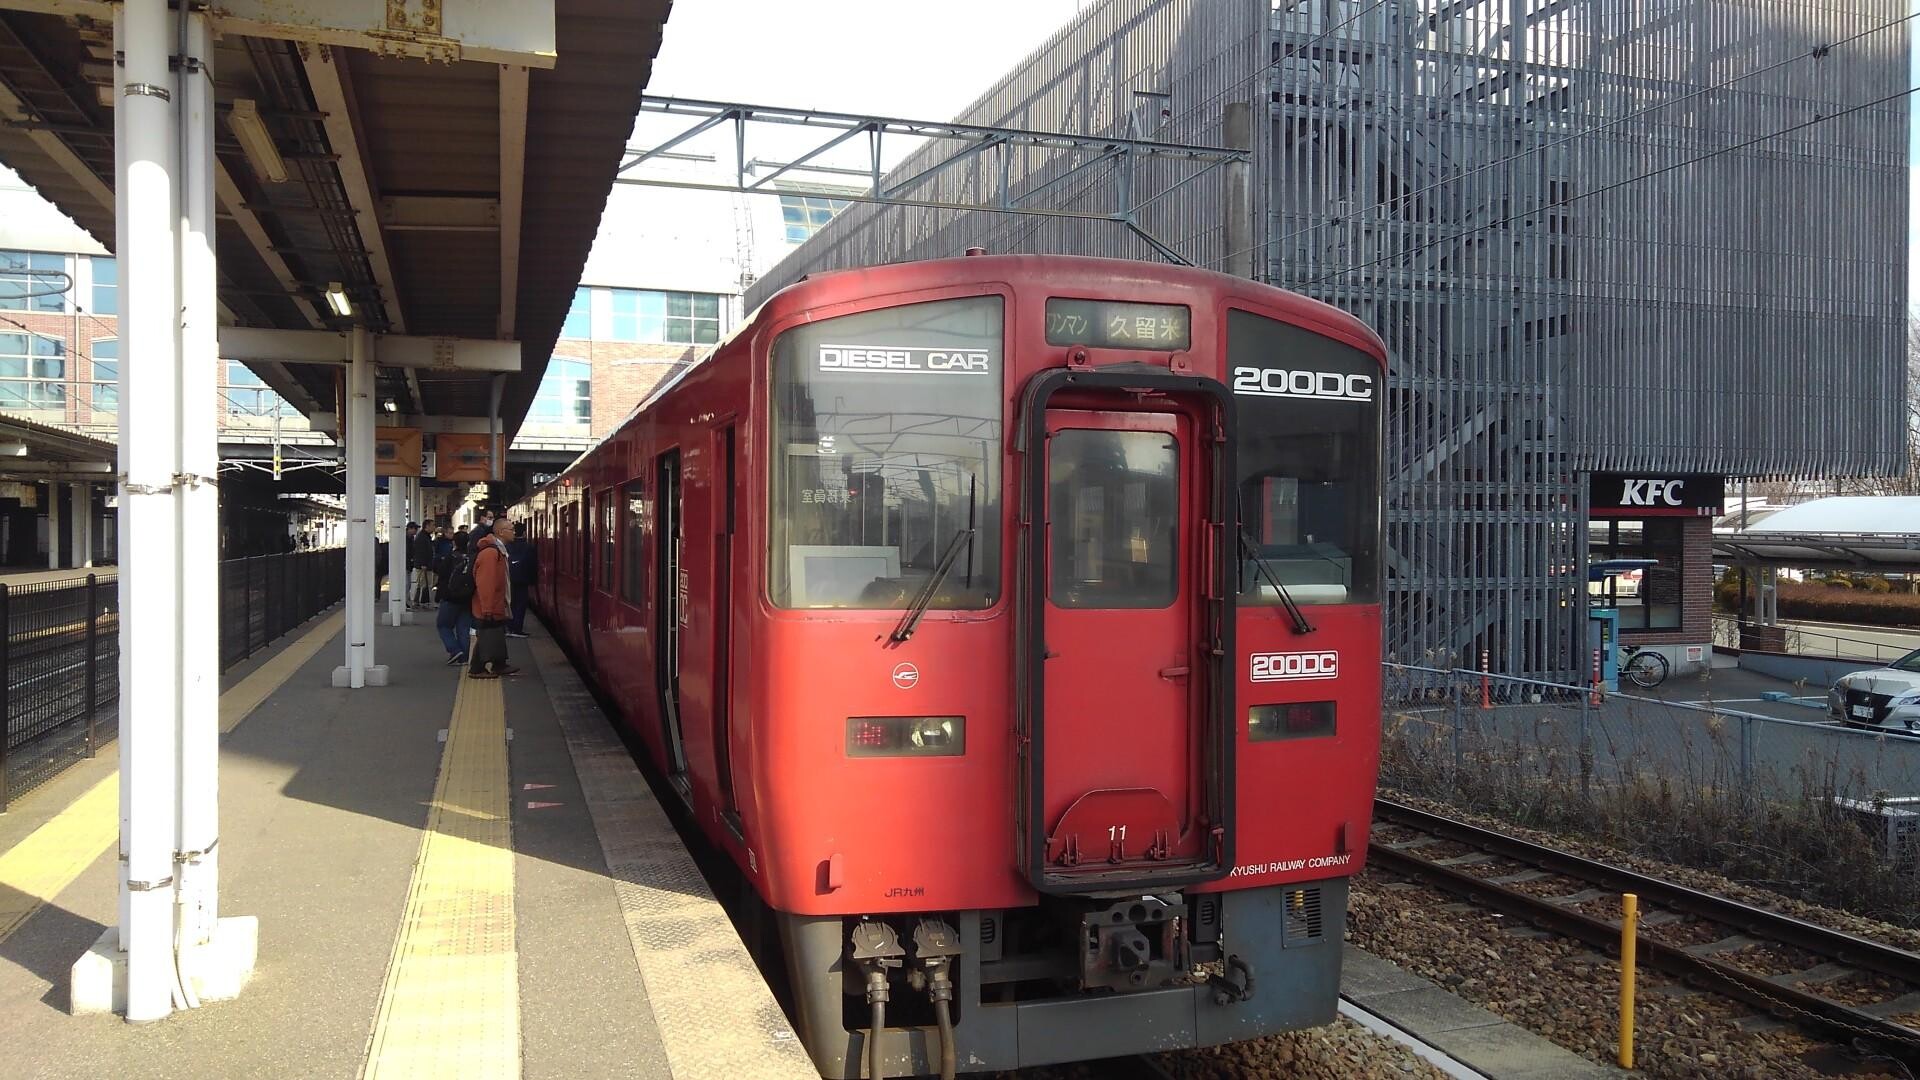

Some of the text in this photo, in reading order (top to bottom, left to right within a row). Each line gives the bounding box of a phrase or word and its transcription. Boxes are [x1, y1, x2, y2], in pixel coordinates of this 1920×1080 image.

[1110, 315, 1181, 340] 久留米
[820, 349, 988, 369] DIESEL CAR
[1234, 366, 1372, 398] 200DC
[1620, 479, 1684, 506] KFC
[1253, 654, 1336, 676] 200DC
[1109, 825, 1126, 840] 11
[1230, 855, 1351, 877] KYUSHU RAILWAY COMPANY
[884, 887, 925, 897] JR九州
